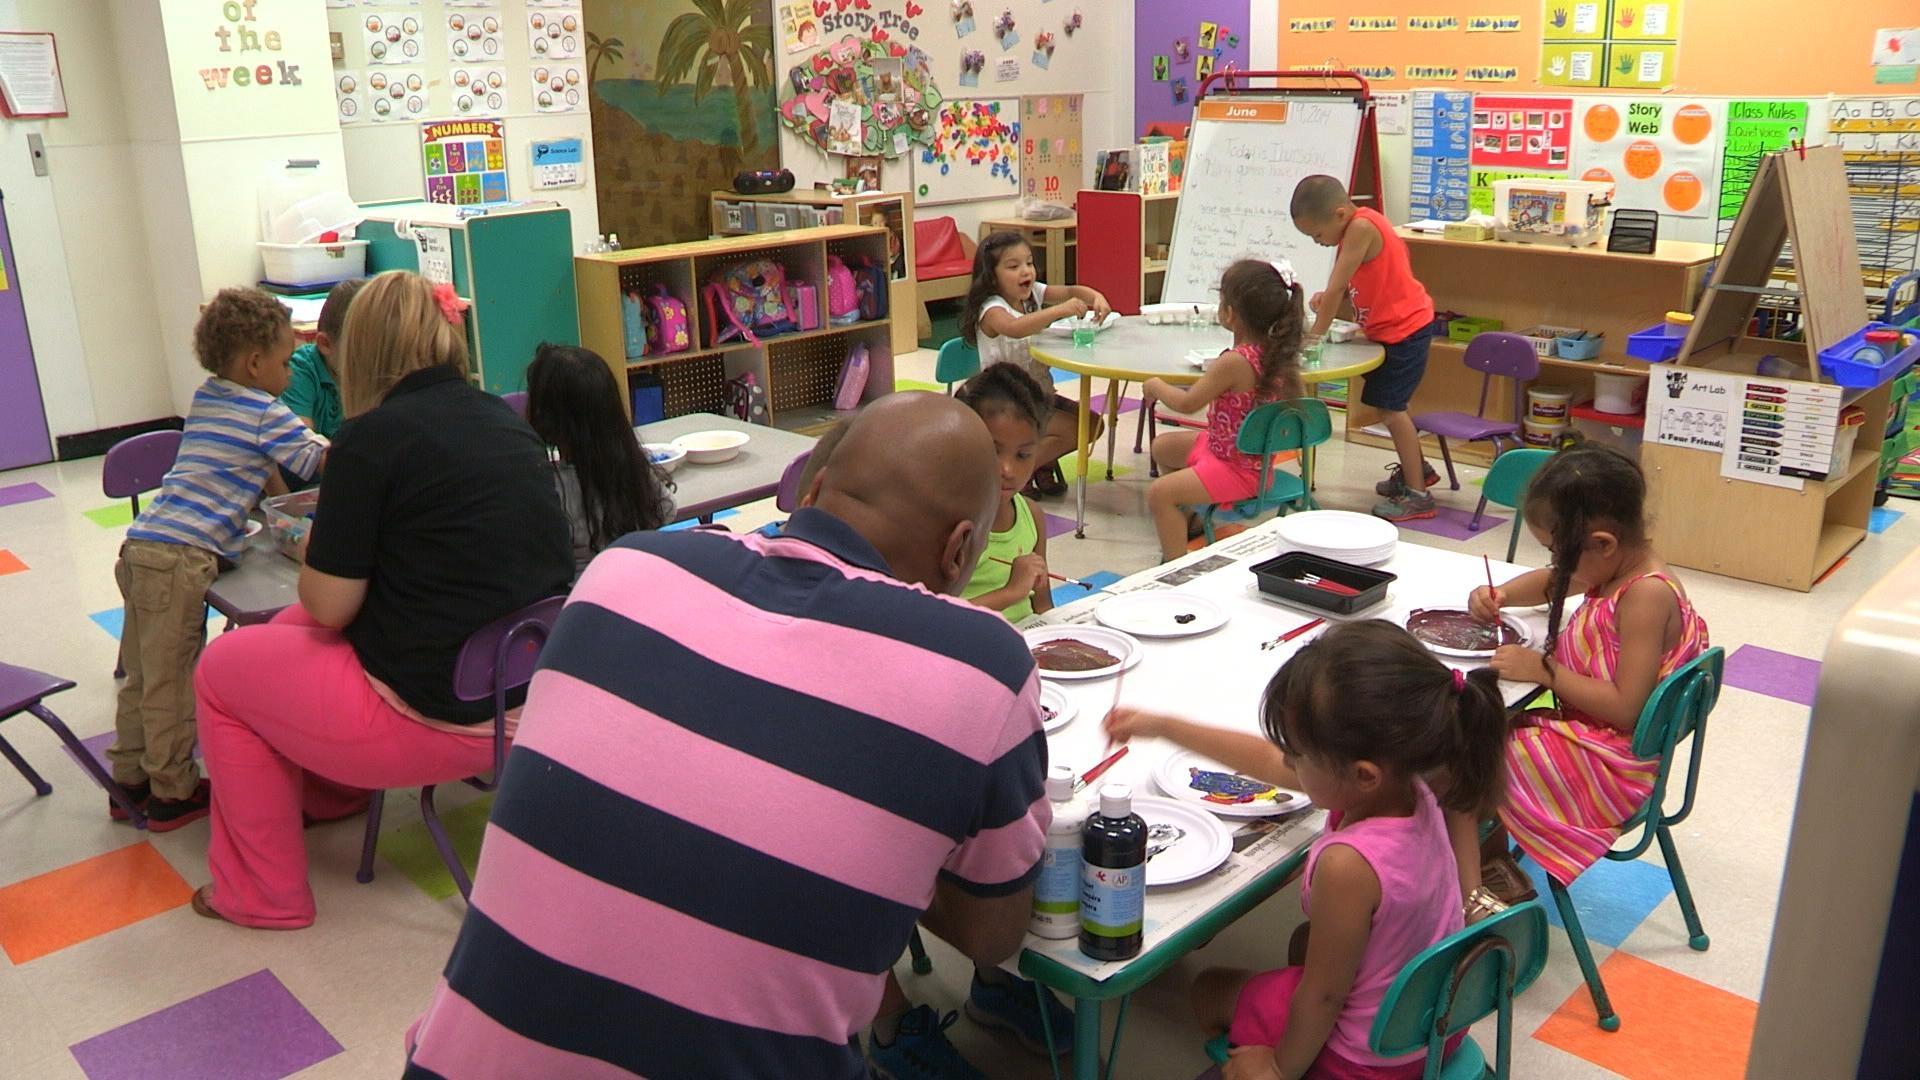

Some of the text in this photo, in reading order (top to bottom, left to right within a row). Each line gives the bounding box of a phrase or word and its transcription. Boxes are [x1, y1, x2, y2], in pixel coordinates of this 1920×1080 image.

[223, 0, 257, 22] of
[822, 11, 875, 33] Story
[879, 10, 919, 40] Tree
[214, 25, 282, 52] the
[198, 60, 302, 91] week
[1226, 106, 1257, 117] June
[1629, 103, 1662, 118] Story
[1734, 101, 1797, 120] Class Rules
[1871, 101, 1895, 117] Bb
[432, 121, 494, 137] NUMBERS
[1629, 121, 1659, 134] Web
[1044, 176, 1059, 191] 10
[1476, 172, 1488, 187] K
[1692, 384, 1726, 394] Art Lab
[1668, 433, 1688, 442] Four
[1116, 874, 1127, 884] AP
